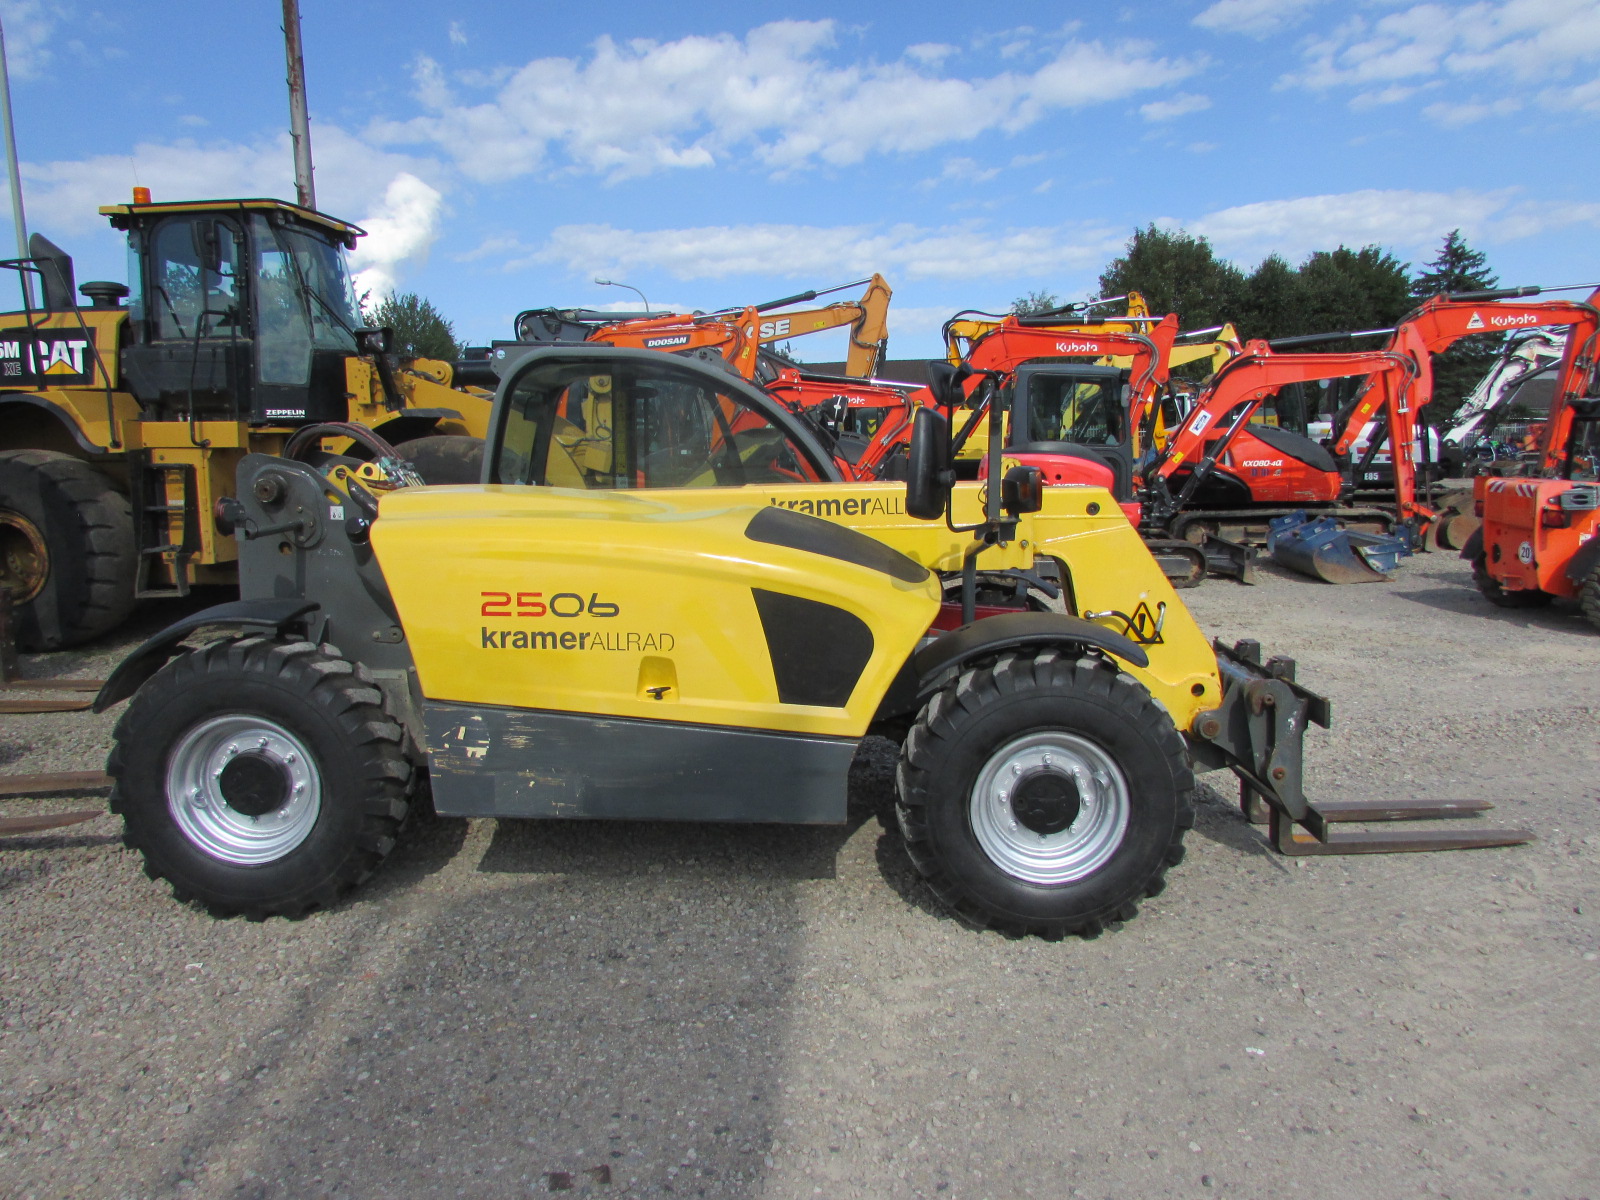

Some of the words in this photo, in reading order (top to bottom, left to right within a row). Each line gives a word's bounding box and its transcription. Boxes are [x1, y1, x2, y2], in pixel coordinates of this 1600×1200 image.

[1491, 313, 1537, 327] Kubota
[746, 319, 791, 339] SE
[647, 336, 688, 348] DOOSAN
[1055, 342, 1098, 353] Kubota
[28, 340, 87, 375] CAT
[4, 361, 22, 376] XE
[1364, 472, 1379, 481] E85
[1520, 546, 1530, 559] 20
[480, 591, 620, 618] 2506
[481, 626, 676, 652] kramerALLRAD
